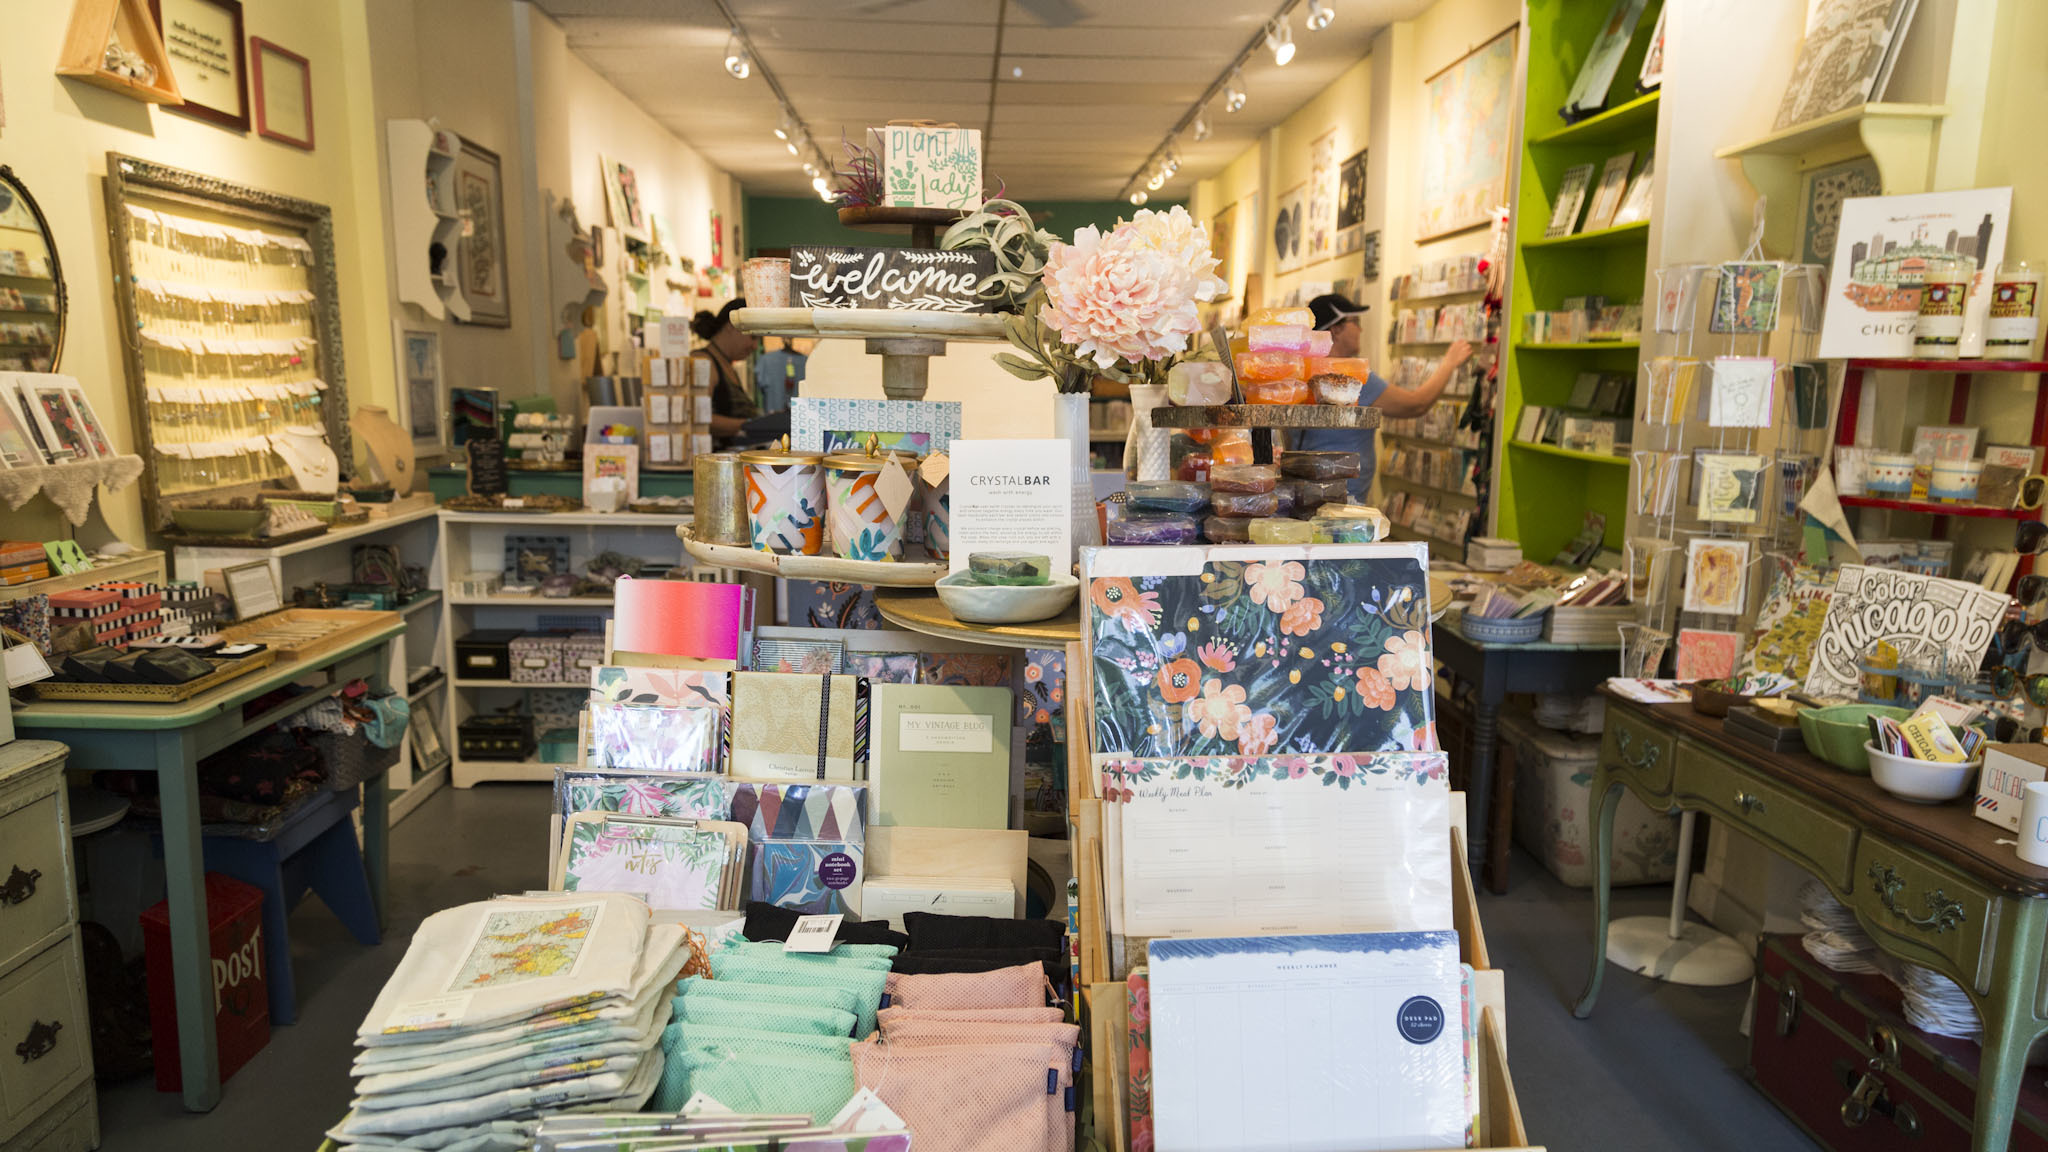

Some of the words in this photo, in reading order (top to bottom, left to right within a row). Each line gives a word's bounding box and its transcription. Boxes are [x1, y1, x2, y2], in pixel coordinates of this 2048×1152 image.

[921, 172, 978, 209] Lady
[790, 252, 978, 300] welcome
[970, 475, 1051, 487] CRYSTALBAR
[1786, 589, 1832, 604] ILLINO
[1860, 573, 1925, 604] Color
[1818, 600, 1958, 687] Chicago
[907, 720, 924, 729] MY
[925, 721, 962, 730] VINTAGE
[1907, 724, 1937, 761] CHICAG
[1139, 788, 1168, 802] Weekly
[1170, 786, 1191, 798] Meal
[1194, 785, 1212, 798] Plan
[1988, 766, 2027, 800] CHiCAG
[211, 924, 261, 1016] POST
